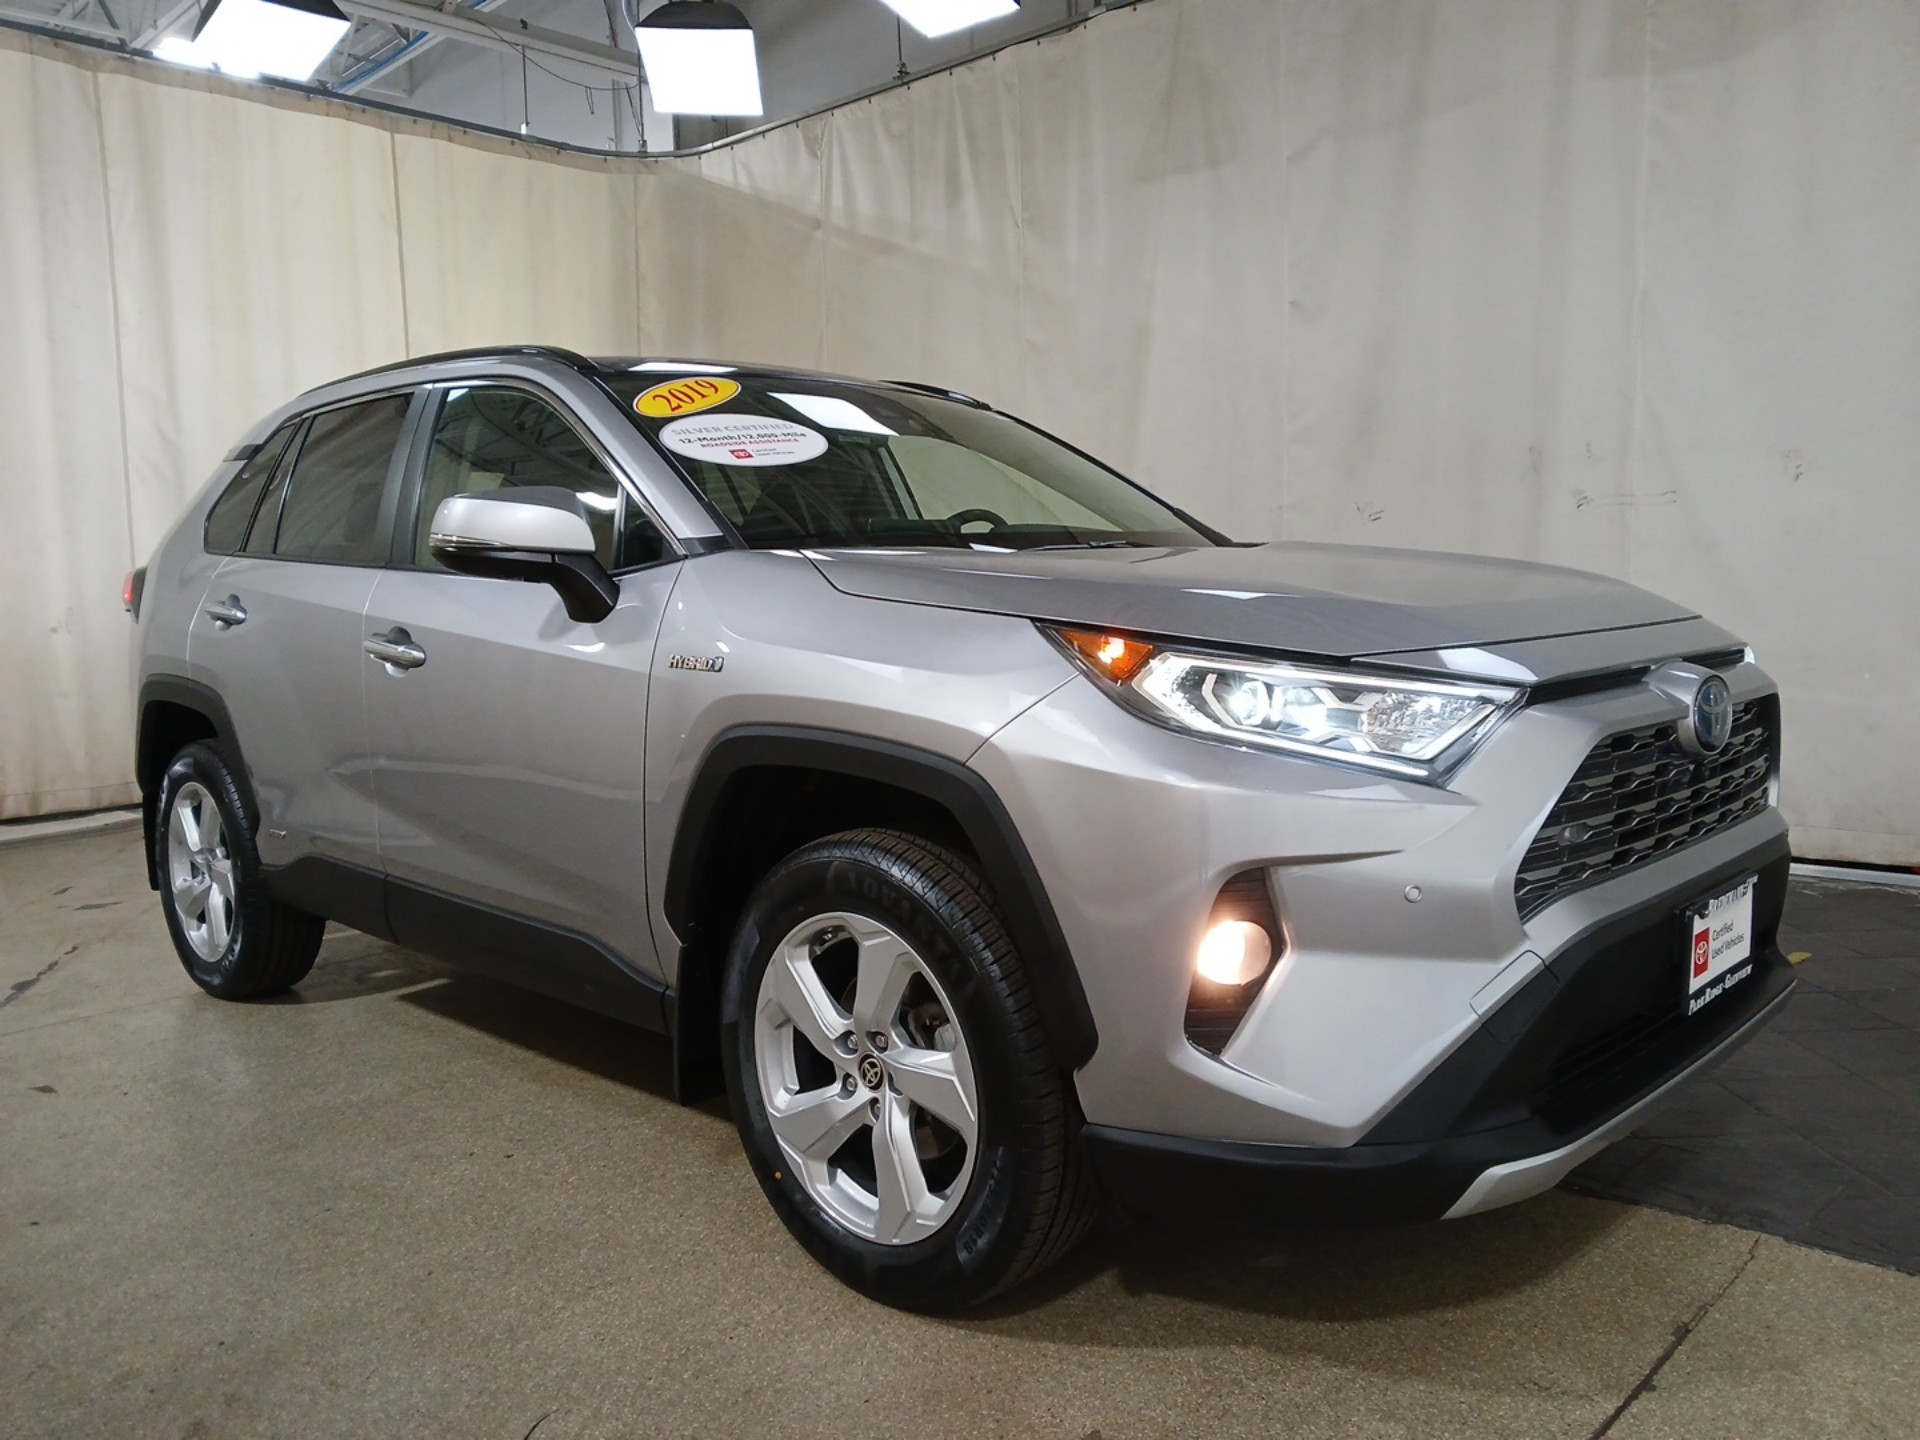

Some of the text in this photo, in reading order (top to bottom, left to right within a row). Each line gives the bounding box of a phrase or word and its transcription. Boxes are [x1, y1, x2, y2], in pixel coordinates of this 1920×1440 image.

[652, 379, 719, 412] 2019
[672, 423, 794, 436] SILVER CERTIFIED
[668, 654, 713, 671] HYBRID
[1711, 919, 1734, 942] Certified
